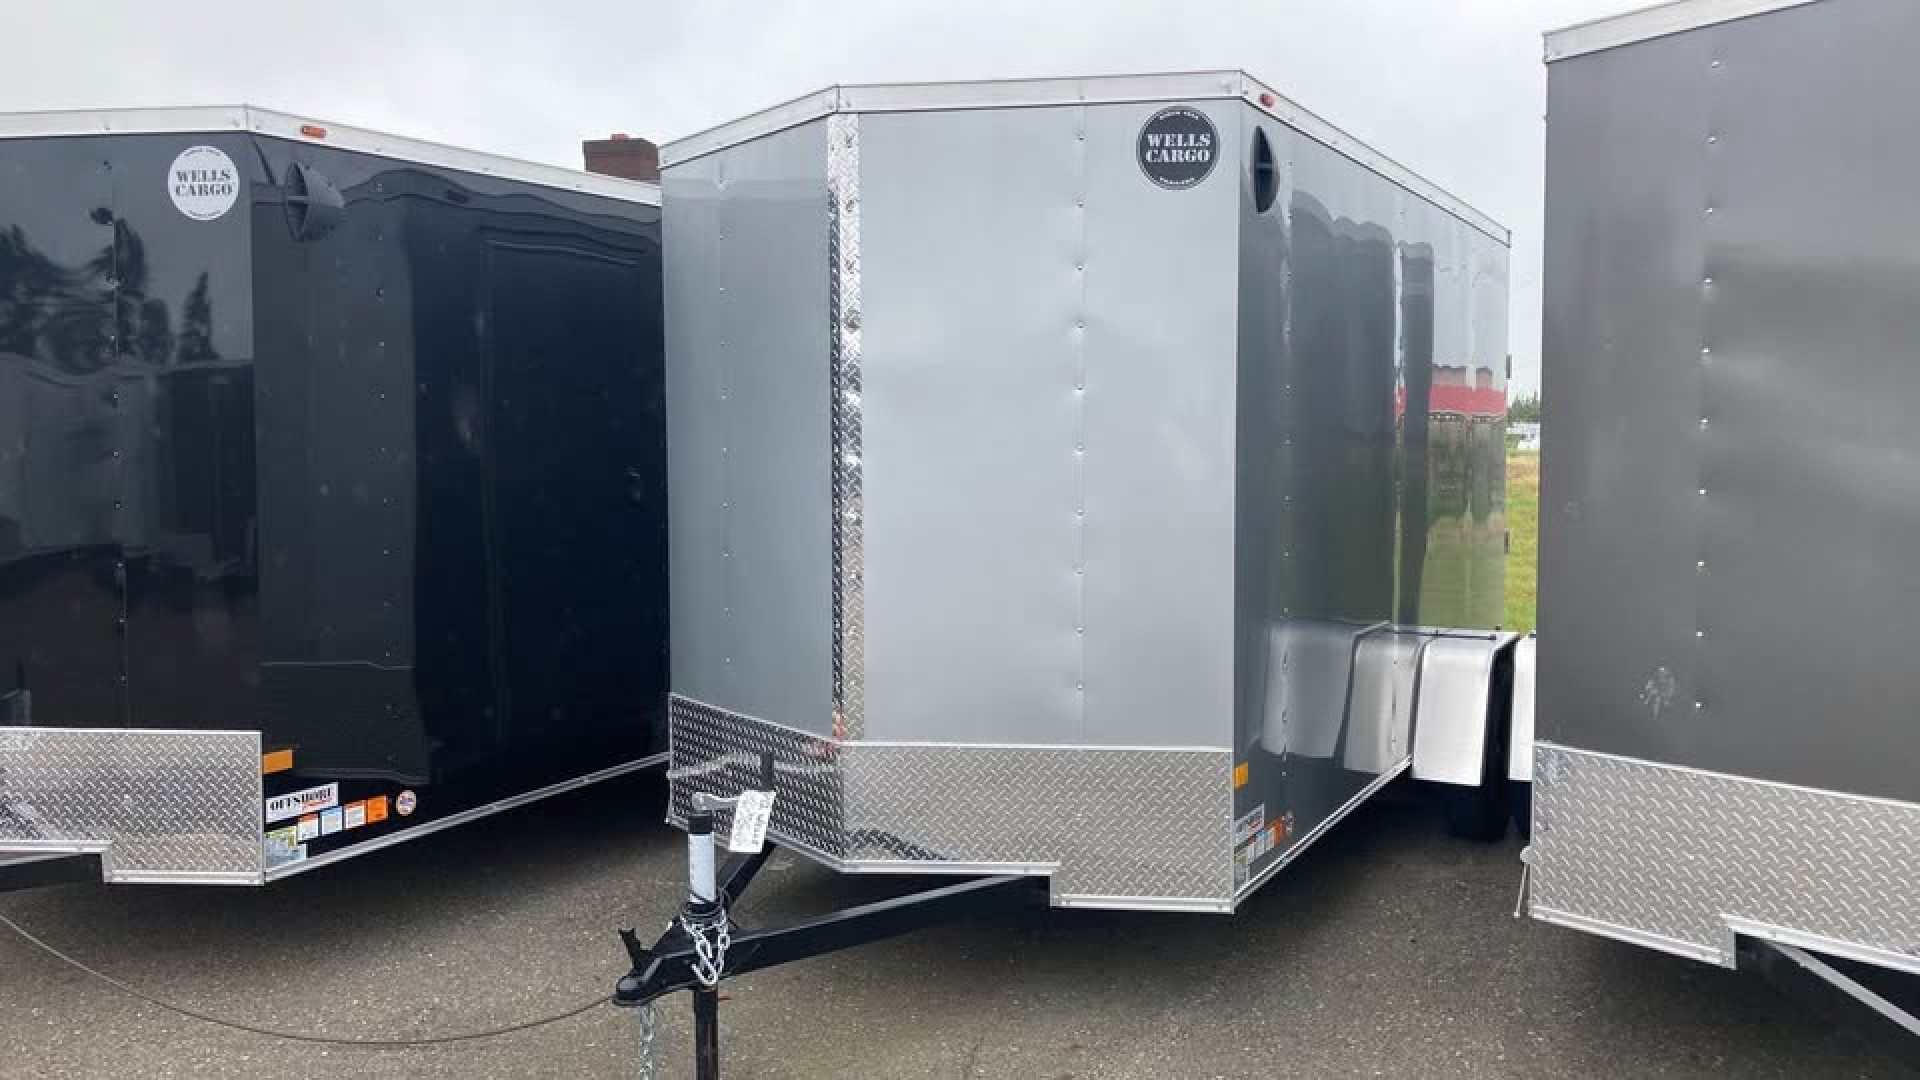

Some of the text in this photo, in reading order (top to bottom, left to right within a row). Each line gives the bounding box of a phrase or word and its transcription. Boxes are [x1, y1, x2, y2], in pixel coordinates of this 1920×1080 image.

[1147, 133, 1211, 147] WELLS
[1145, 149, 1211, 163] CARGO
[175, 169, 231, 183] WELLS
[175, 183, 233, 197] CARGO
